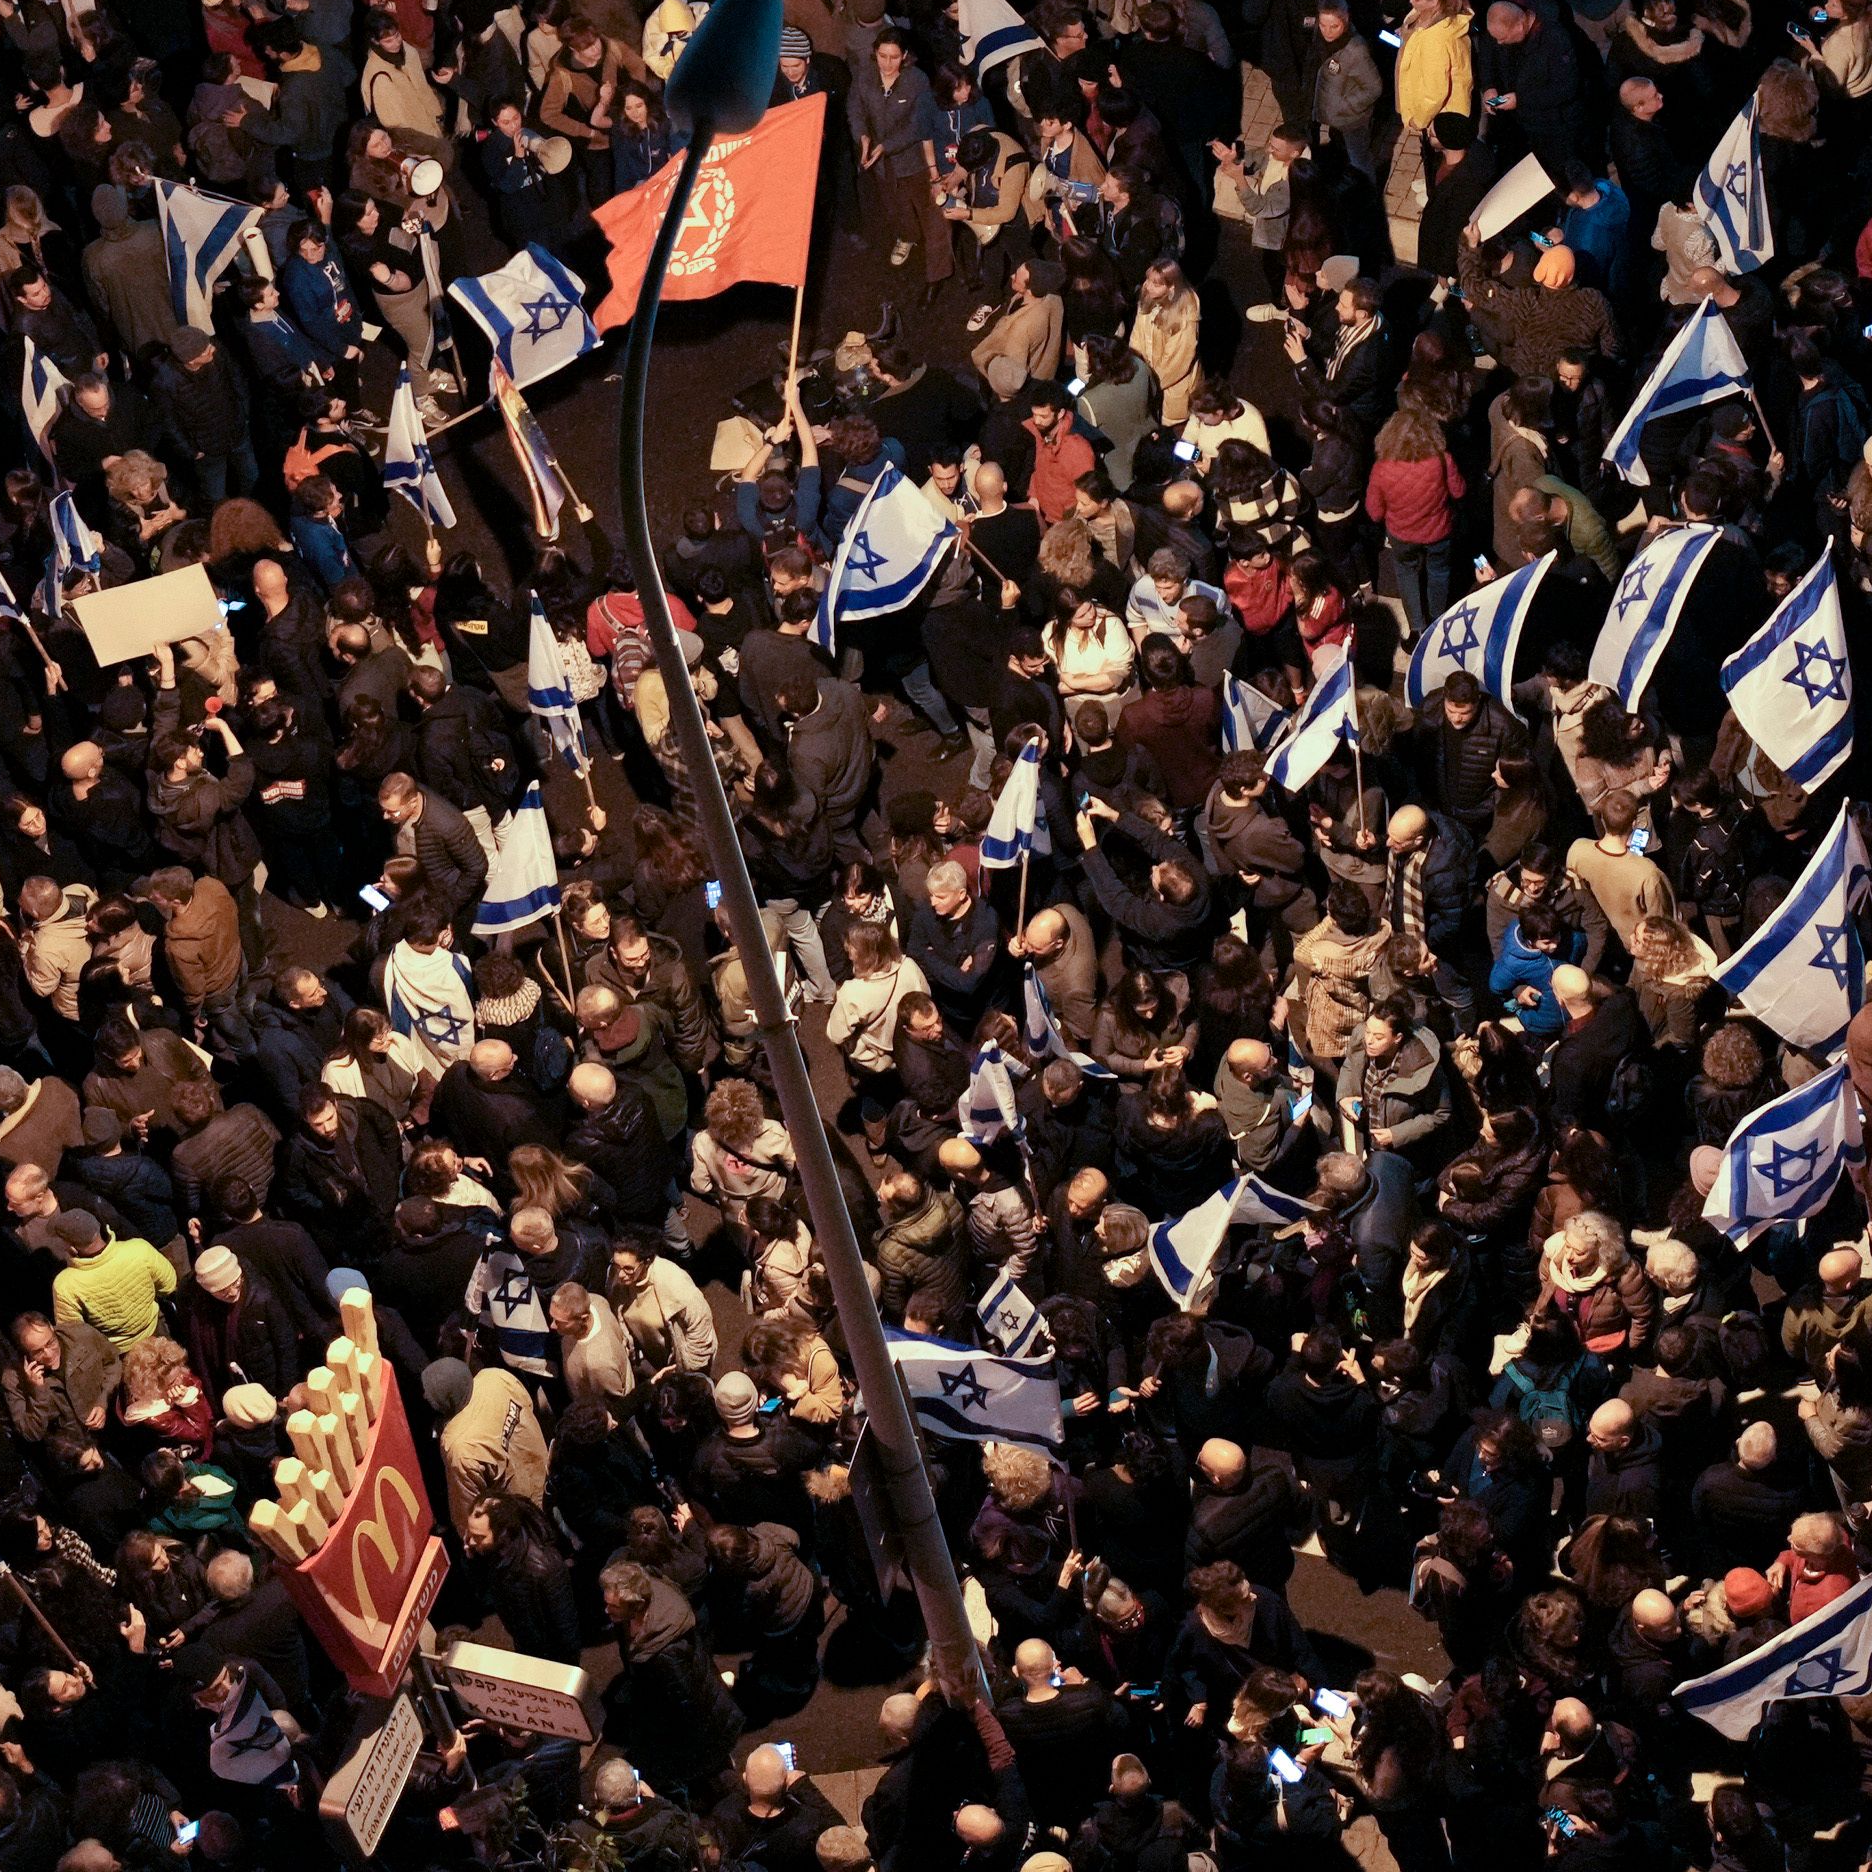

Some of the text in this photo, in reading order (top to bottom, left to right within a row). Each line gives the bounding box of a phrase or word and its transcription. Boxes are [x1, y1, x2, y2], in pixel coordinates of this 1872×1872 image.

[392, 1569, 438, 1670] משלוחים
[456, 1674, 497, 1693] קפלן
[504, 1688, 548, 1704] אליעזר
[467, 1702, 555, 1729] KAPLAN
[375, 1717, 398, 1767] לאונרדו
[368, 1764, 377, 1782] דה
[365, 1788, 393, 1847] LEONARDO
[390, 1773, 400, 1787] DA
[397, 1743, 413, 1772] VINCI
